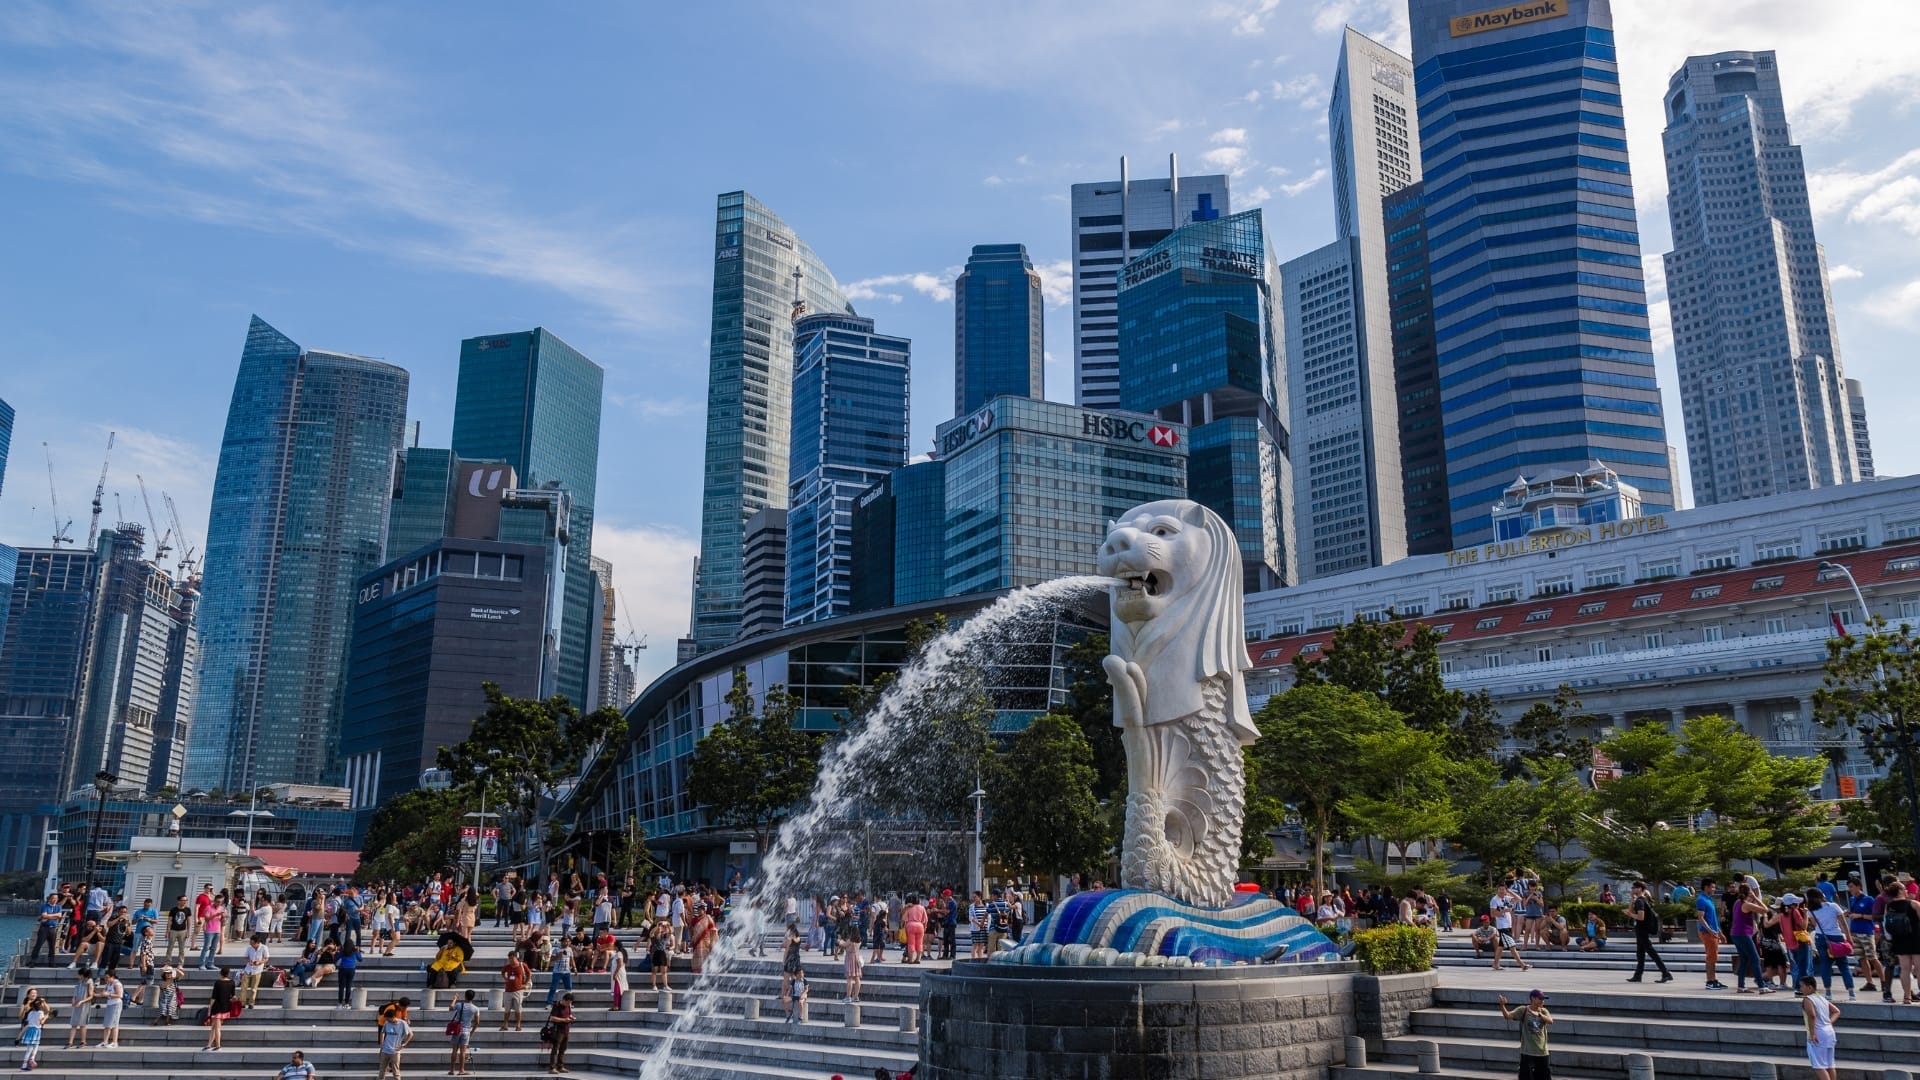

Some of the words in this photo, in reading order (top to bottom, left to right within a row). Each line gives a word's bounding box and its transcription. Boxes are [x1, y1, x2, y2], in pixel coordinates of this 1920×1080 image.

[1474, 2, 1556, 27] Maybank
[718, 247, 738, 259] ANZ
[1124, 249, 1169, 276] STRAITS
[1203, 247, 1256, 263] STRAITS
[1125, 260, 1171, 287] TRADING
[1201, 258, 1257, 276] TRADING
[944, 418, 976, 455] HSBC
[1082, 414, 1145, 442] HSBC
[1445, 551, 1478, 566] THE
[1485, 528, 1591, 560] FULLERTON
[1600, 514, 1668, 539] HOTEL
[359, 582, 380, 604] OUE
